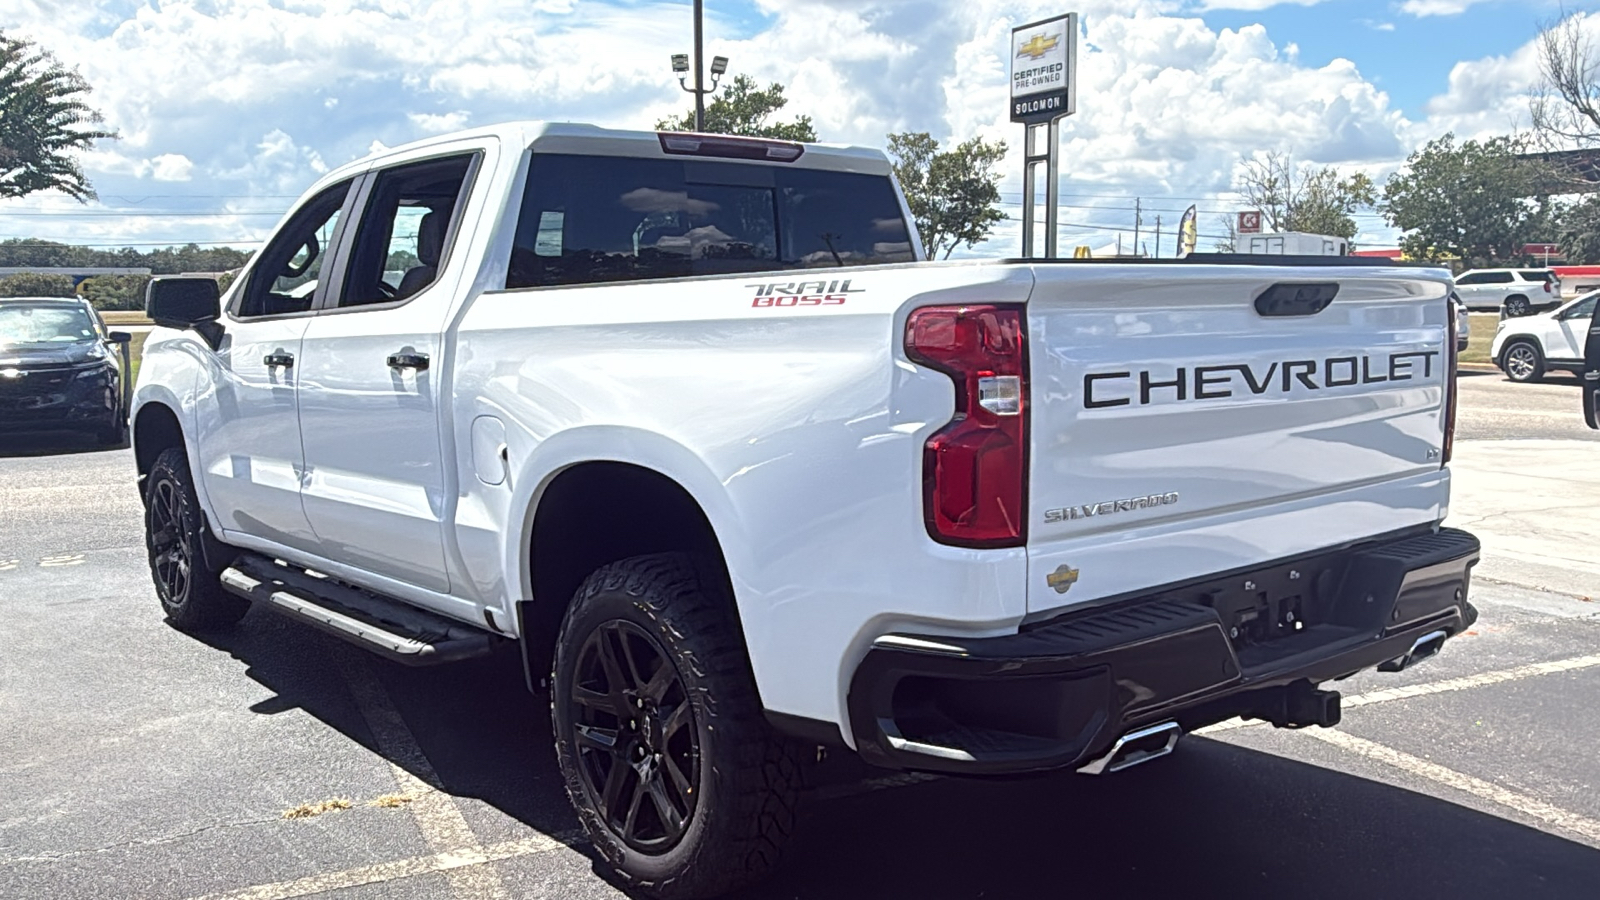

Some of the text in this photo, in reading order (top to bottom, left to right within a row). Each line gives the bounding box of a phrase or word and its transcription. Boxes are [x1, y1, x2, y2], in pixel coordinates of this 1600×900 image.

[1014, 63, 1062, 80] CERTIFIED
[1016, 73, 1060, 89] PRE-OWNED
[1015, 97, 1060, 114] SOLOMON
[744, 279, 866, 297] TRAIL
[751, 294, 848, 308] BOSS
[1083, 350, 1439, 410] CHEVROLET
[1043, 490, 1179, 524] SILVERADO
